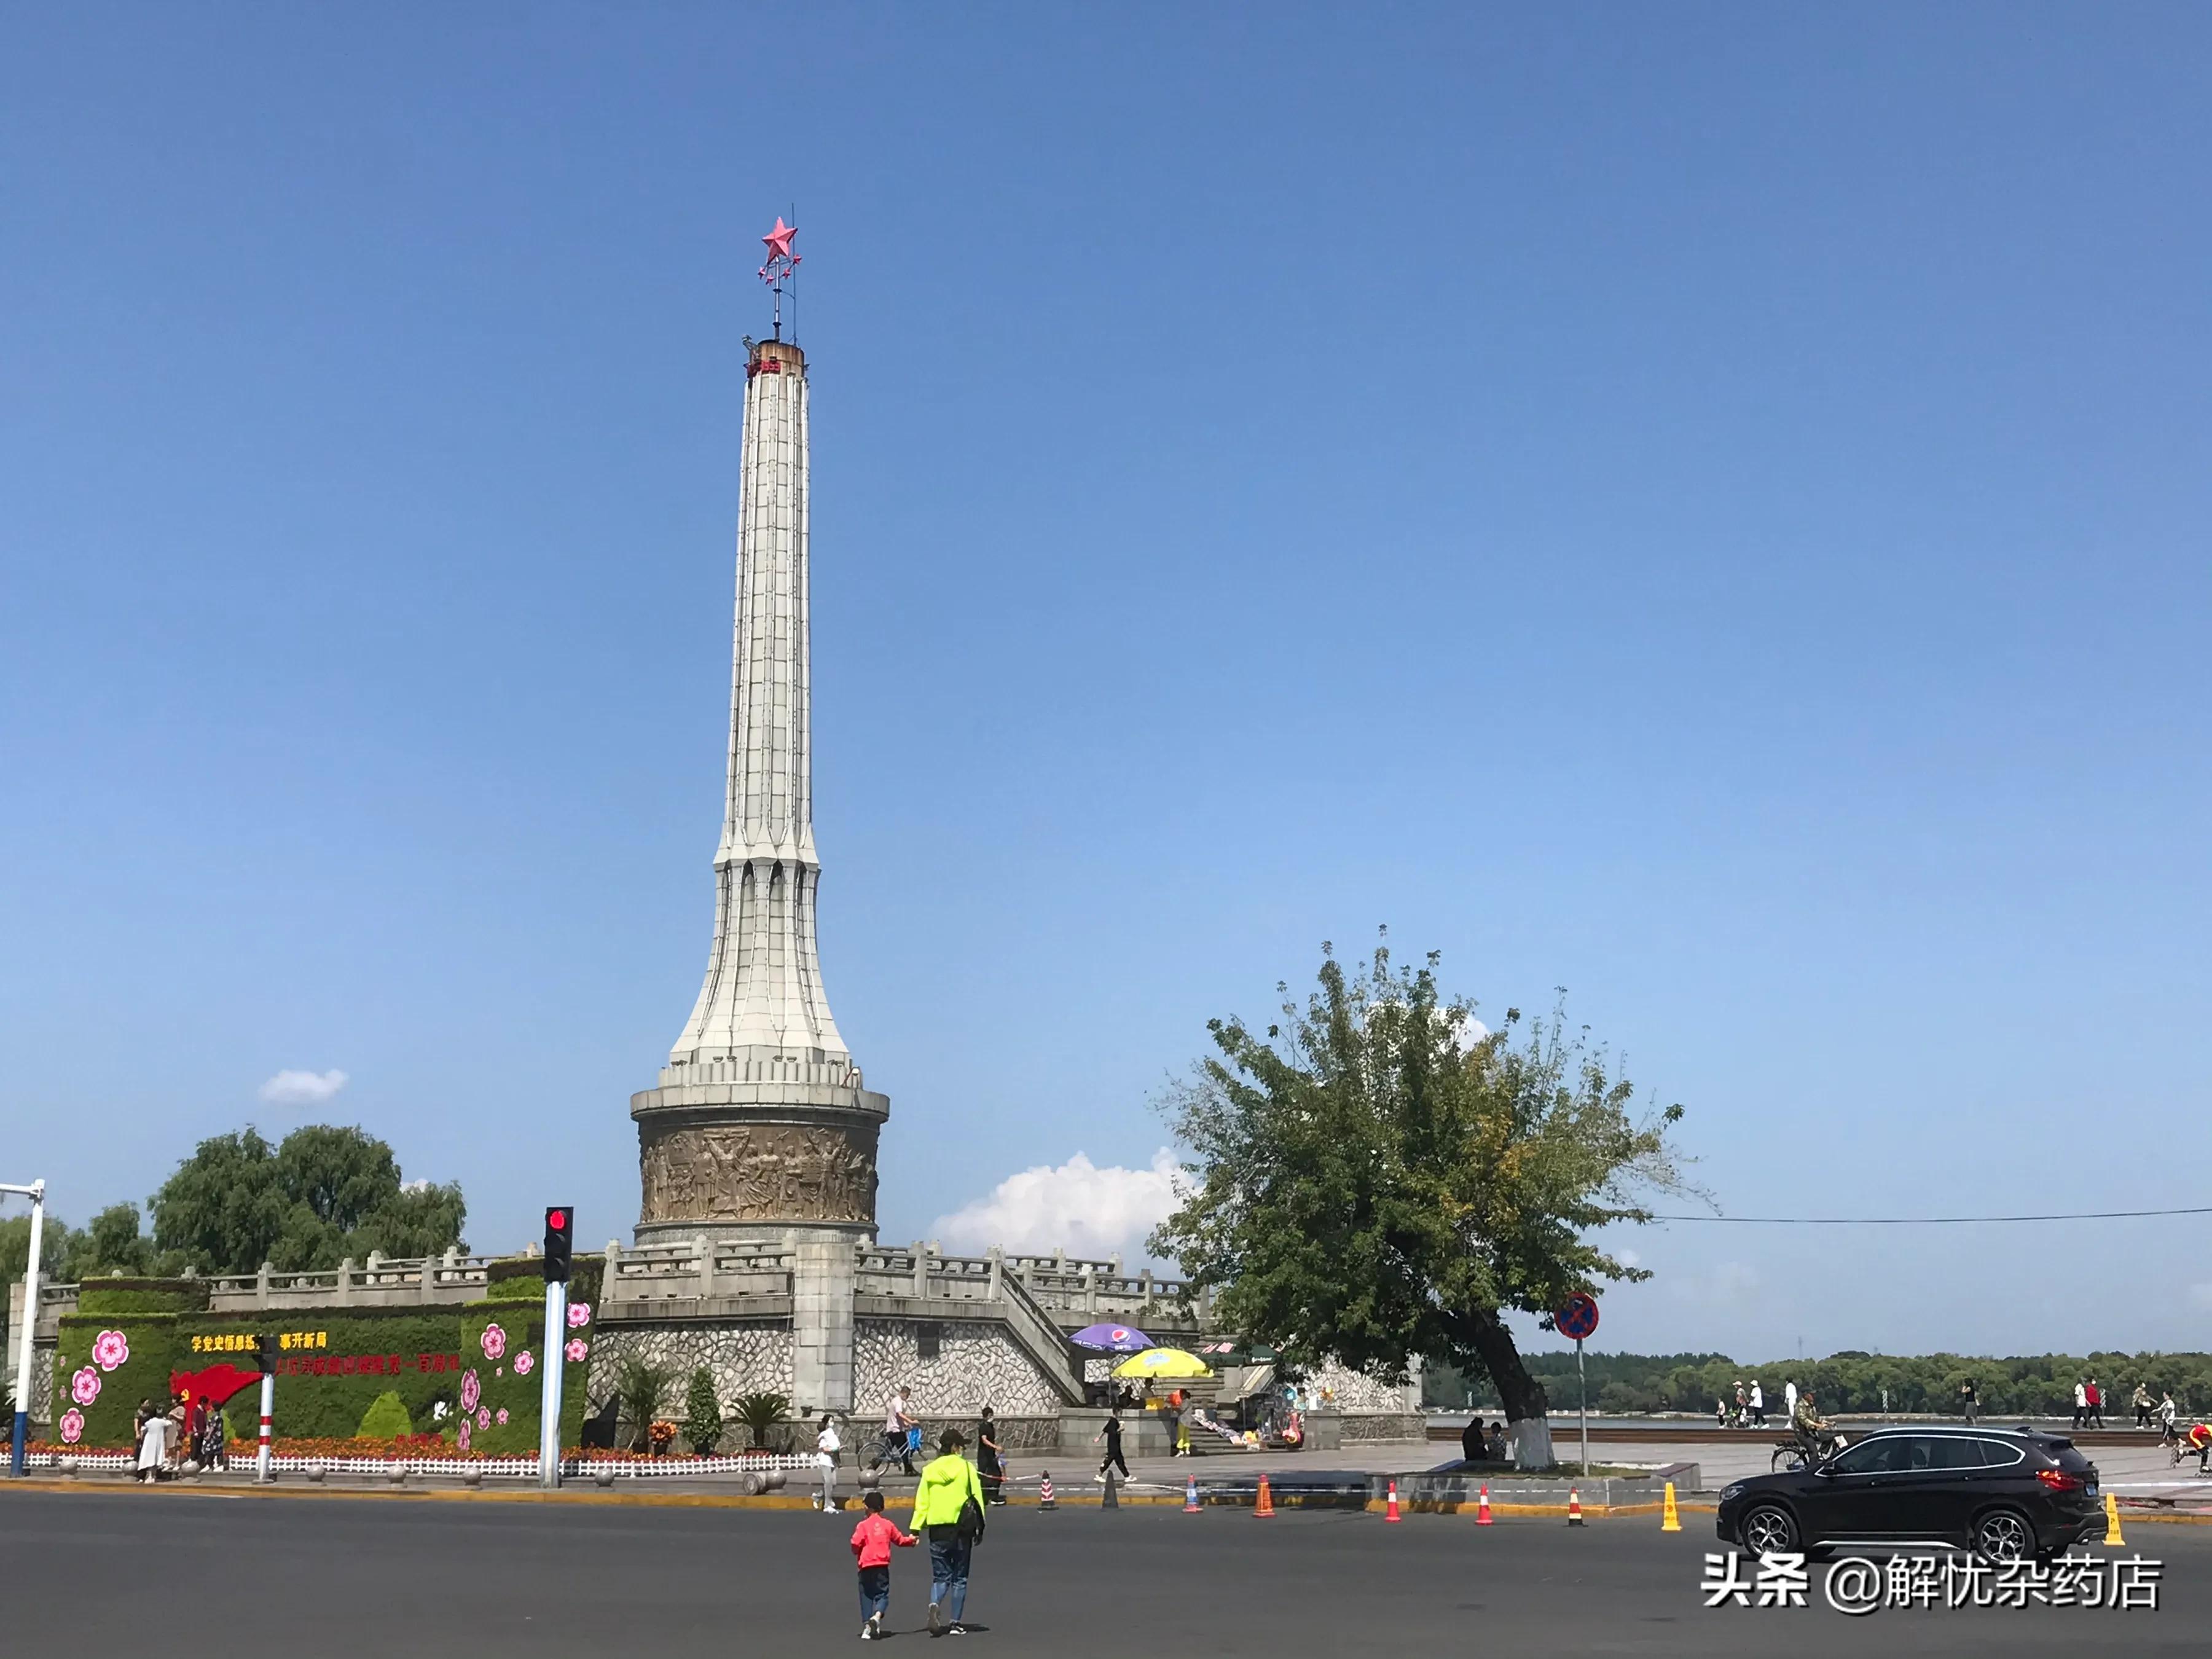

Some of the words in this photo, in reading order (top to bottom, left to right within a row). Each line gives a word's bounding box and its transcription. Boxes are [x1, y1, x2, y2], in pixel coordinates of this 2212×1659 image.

[191, 1332, 326, 1352] 学党史悟思想事开新局
